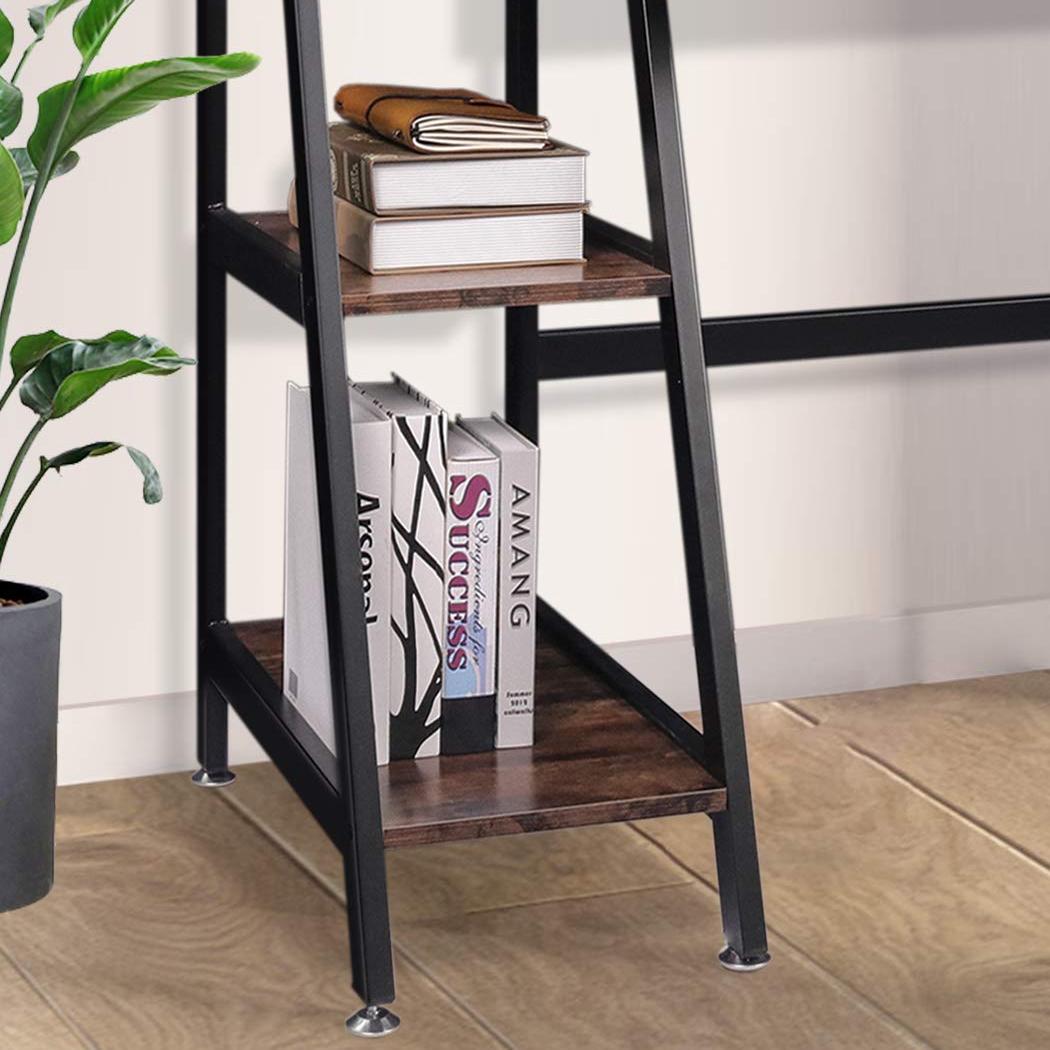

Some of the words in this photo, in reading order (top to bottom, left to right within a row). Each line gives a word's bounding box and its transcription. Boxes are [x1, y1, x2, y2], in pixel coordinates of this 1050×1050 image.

[468, 520, 490, 634] Ingredients
[510, 483, 532, 629] AMANG
[468, 636, 486, 666] for
